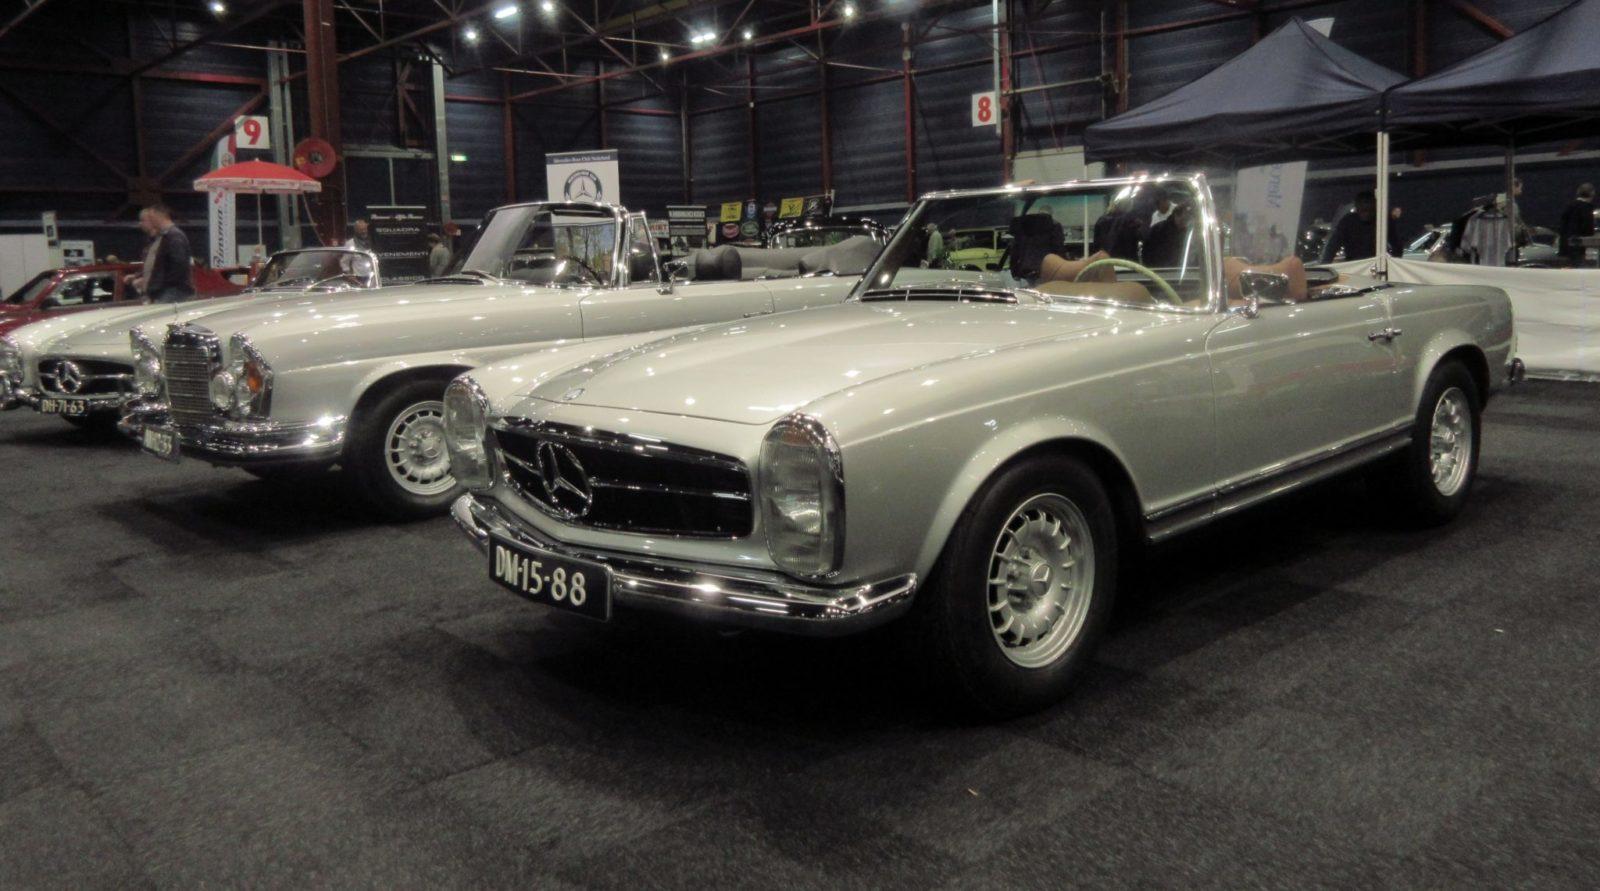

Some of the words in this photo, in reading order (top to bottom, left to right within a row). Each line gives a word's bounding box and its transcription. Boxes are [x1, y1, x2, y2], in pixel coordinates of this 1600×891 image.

[978, 96, 991, 123] 8
[243, 119, 261, 146] 9
[495, 545, 586, 606] DM-15-88
